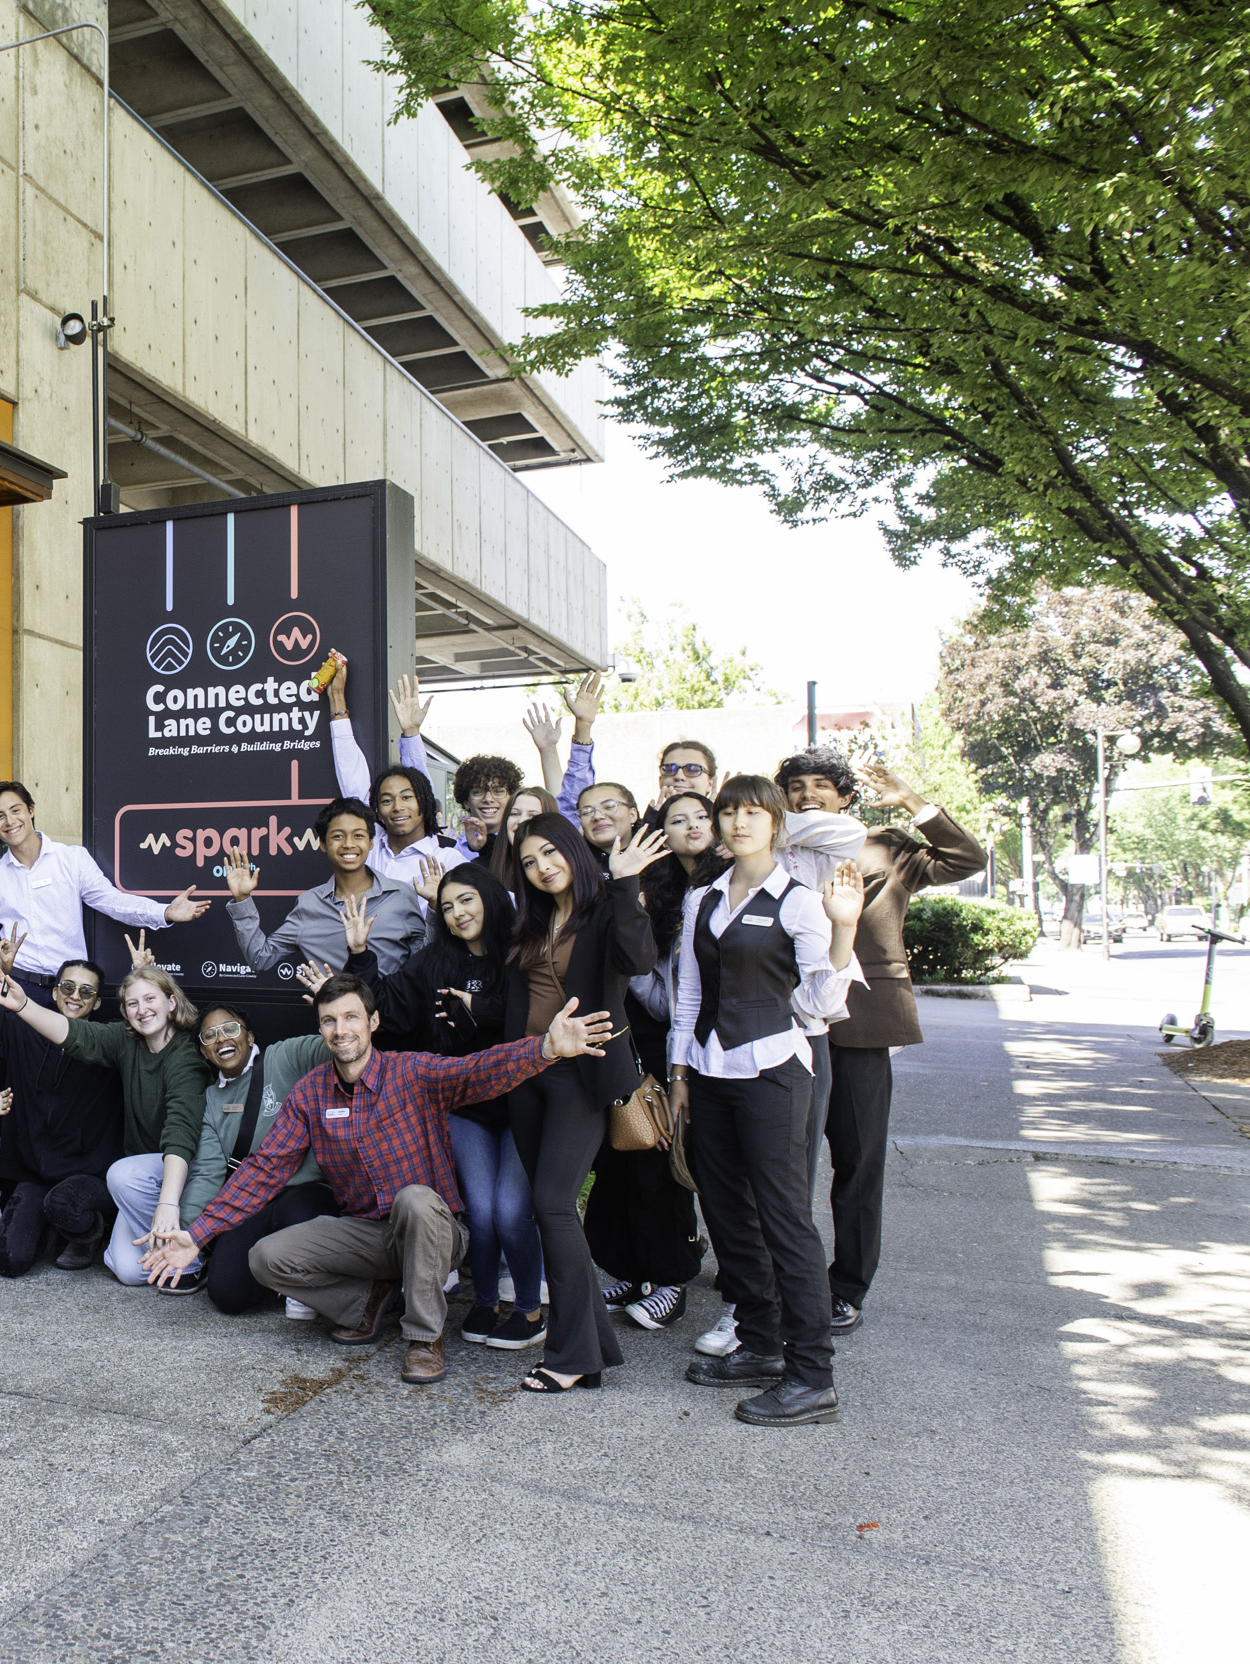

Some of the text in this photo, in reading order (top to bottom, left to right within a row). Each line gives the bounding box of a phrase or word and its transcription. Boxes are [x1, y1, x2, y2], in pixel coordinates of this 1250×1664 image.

[146, 672, 321, 712] Connected
[148, 706, 321, 738] Lane County
[148, 740, 321, 756] Breaking Barriers & Building Bridges
[174, 815, 293, 867] spark
[219, 963, 256, 974] Naviga
